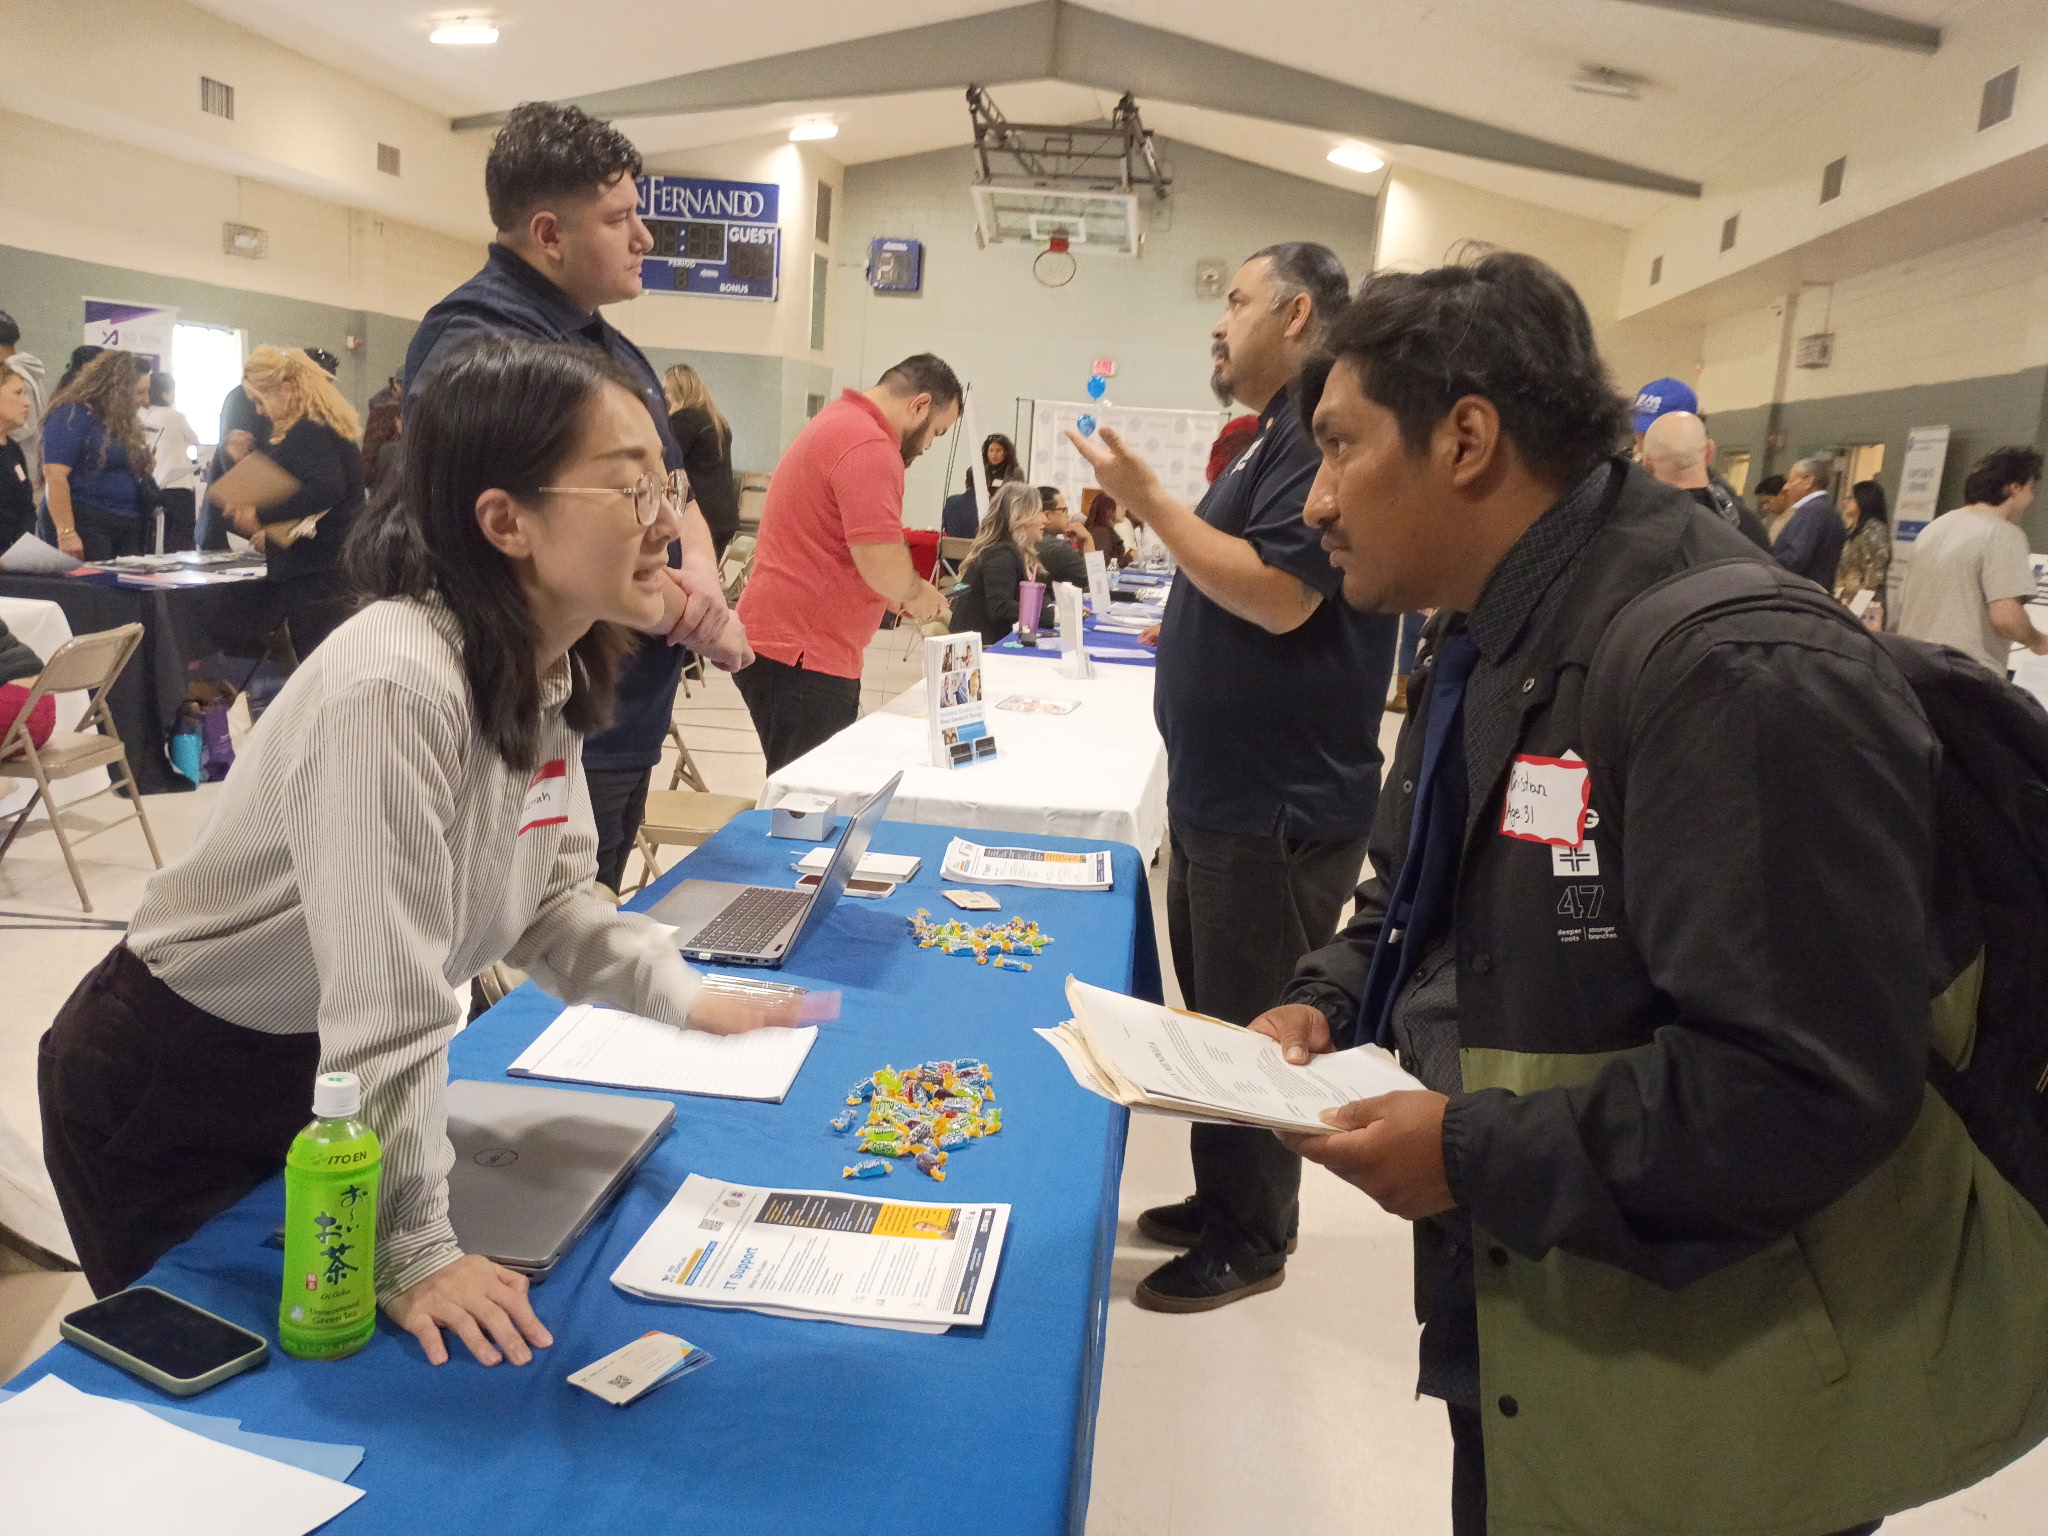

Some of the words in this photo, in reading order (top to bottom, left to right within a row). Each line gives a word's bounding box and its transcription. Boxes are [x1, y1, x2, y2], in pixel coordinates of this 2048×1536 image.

[649, 175, 764, 218] FERNANDO
[729, 227, 774, 243] GUEST
[668, 258, 696, 268] PERIOD
[719, 282, 749, 294] BONUS
[1524, 804, 1534, 824] 31
[1557, 884, 1604, 919] 47
[729, 1247, 758, 1280] Support
